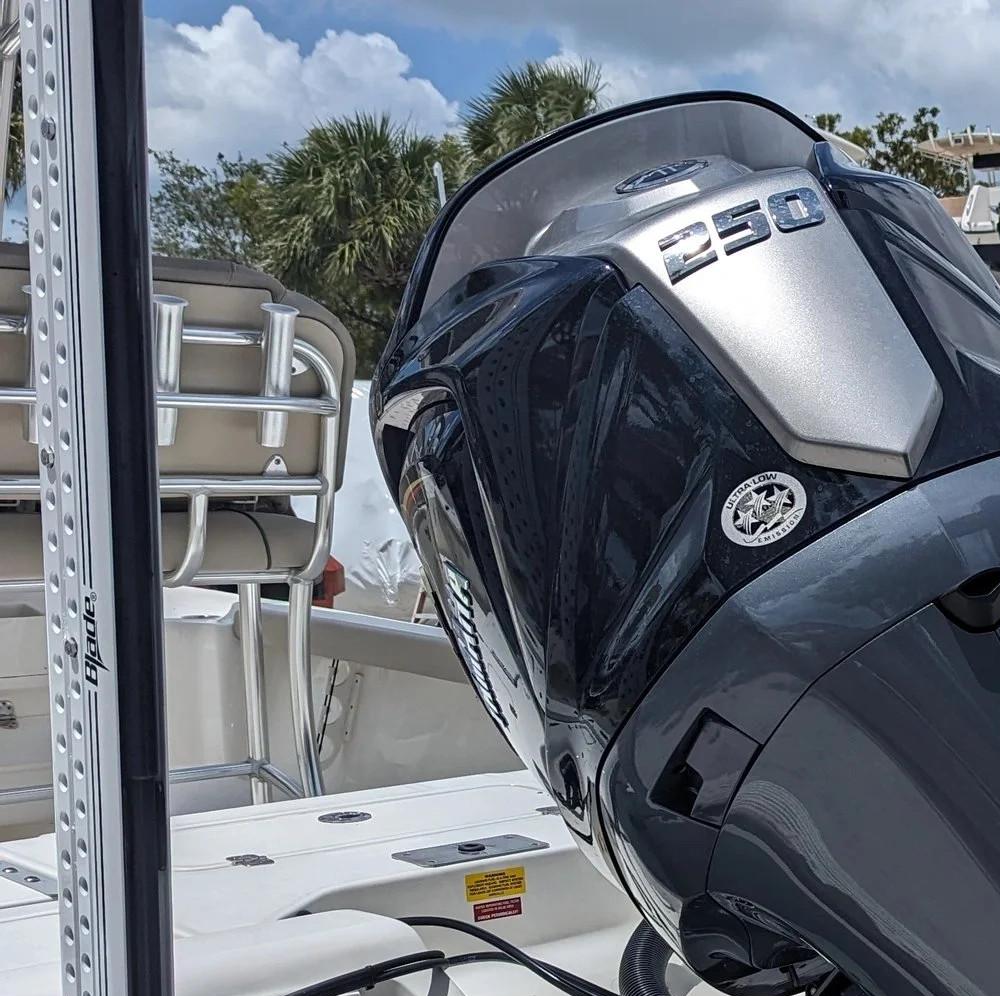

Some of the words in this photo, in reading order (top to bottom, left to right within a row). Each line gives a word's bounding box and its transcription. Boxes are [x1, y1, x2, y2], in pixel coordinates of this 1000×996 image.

[658, 187, 826, 286] 250
[758, 513, 800, 544] EMISSION
[83, 596, 109, 687] Blade
